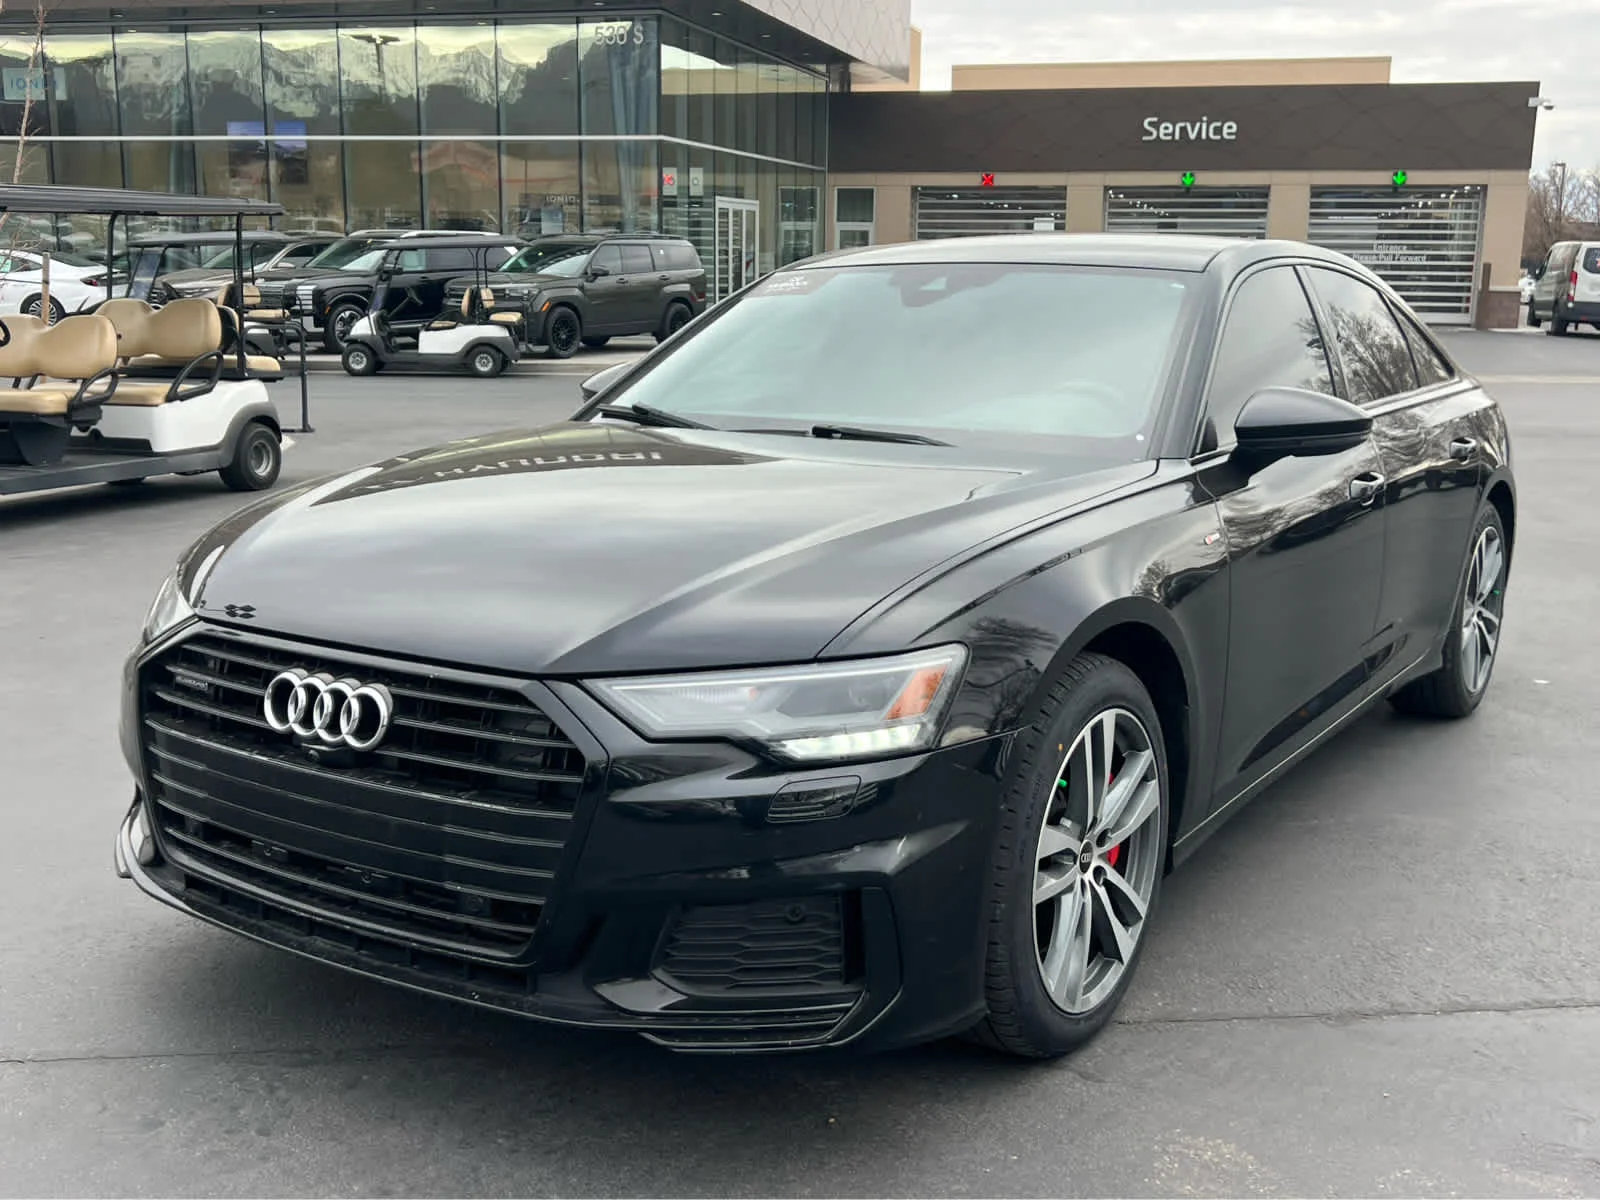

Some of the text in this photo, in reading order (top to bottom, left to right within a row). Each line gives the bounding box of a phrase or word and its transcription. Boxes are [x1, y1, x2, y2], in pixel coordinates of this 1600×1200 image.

[594, 23, 644, 45] 530 S
[1142, 116, 1238, 141] Service
[1373, 242, 1407, 252] Entrance
